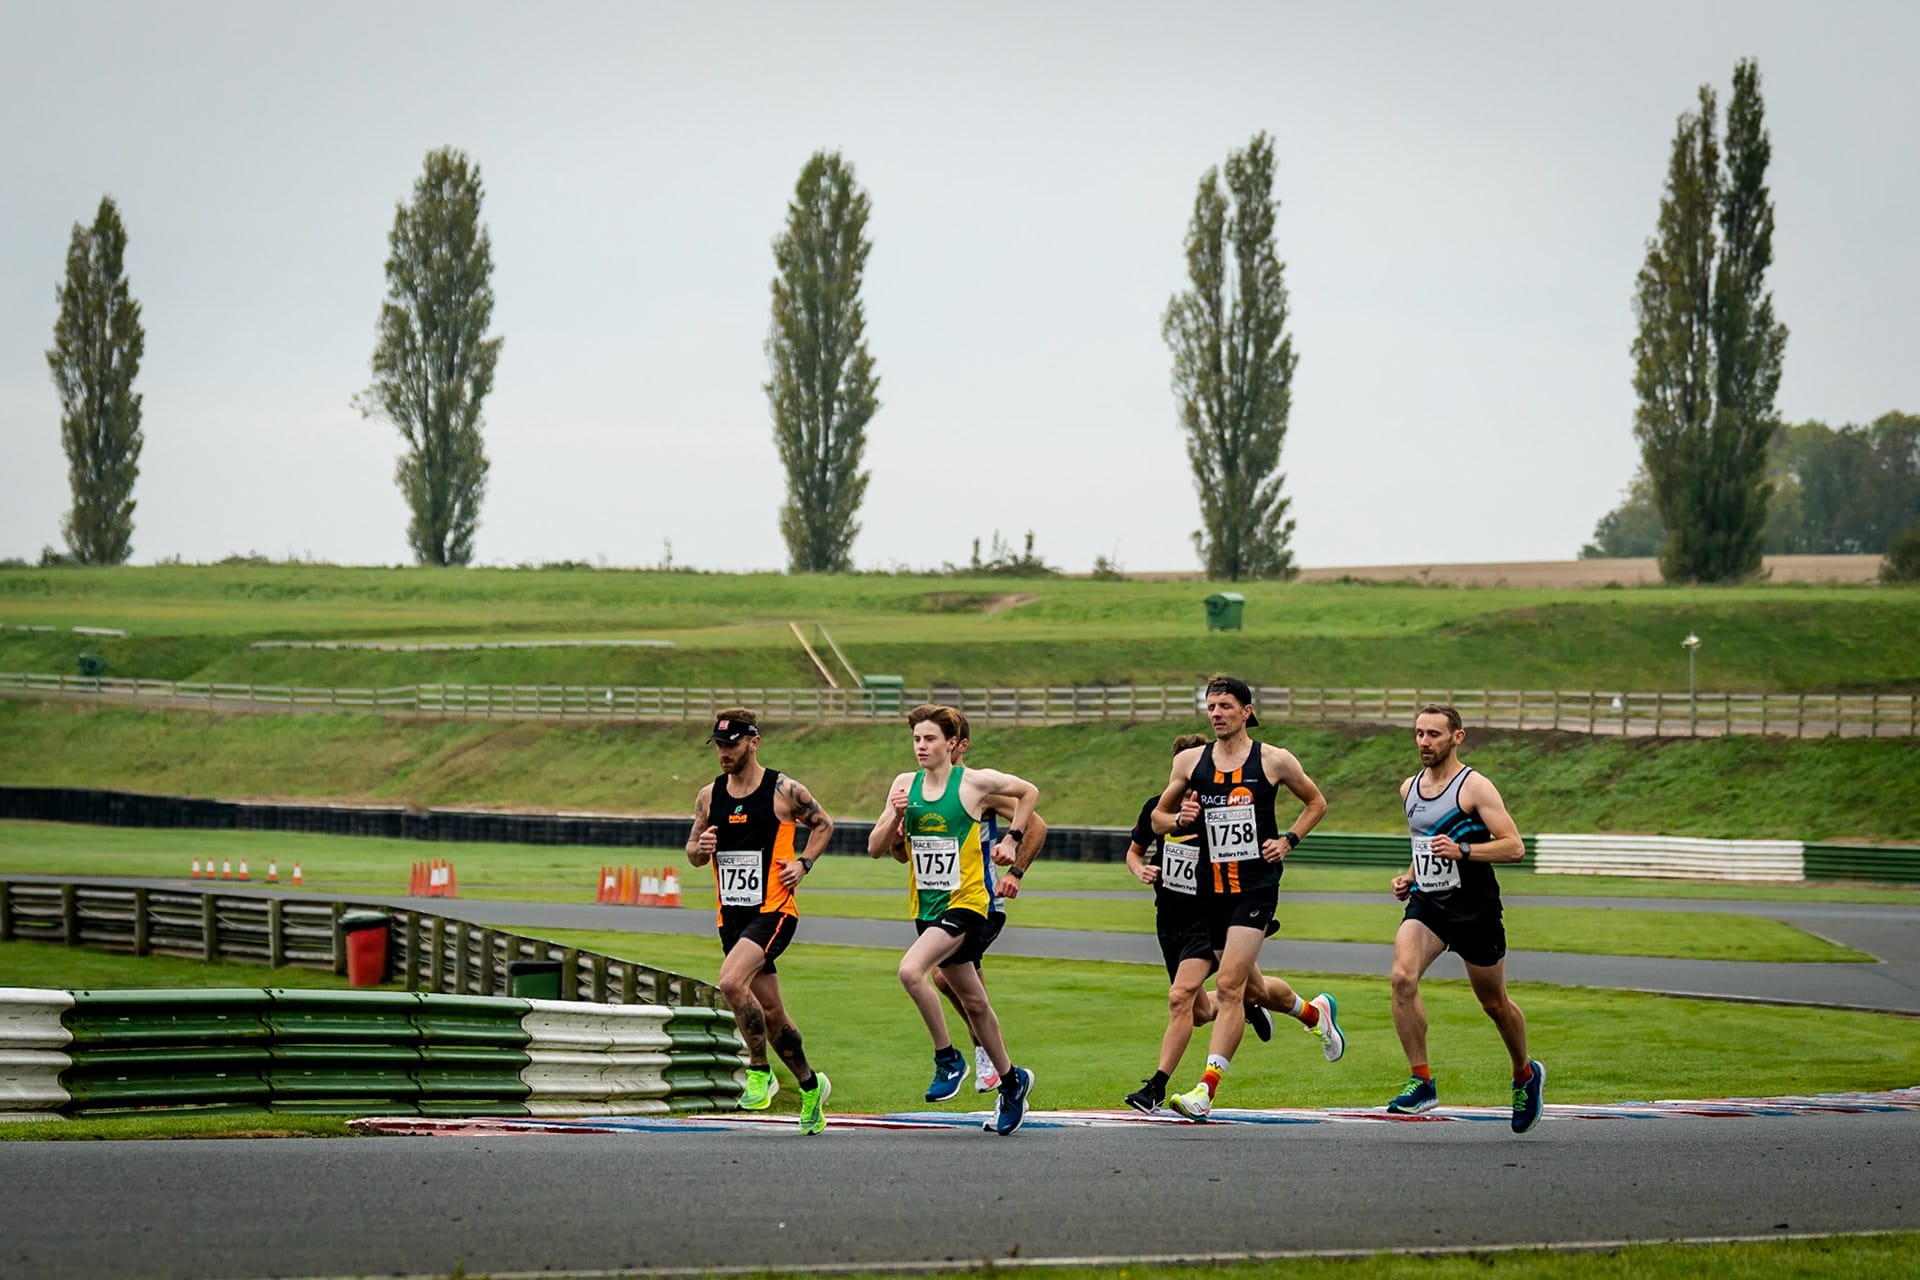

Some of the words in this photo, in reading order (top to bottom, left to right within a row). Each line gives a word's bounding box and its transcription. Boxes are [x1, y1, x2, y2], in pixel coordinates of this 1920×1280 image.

[1200, 795, 1227, 805] RACE
[1208, 812, 1227, 821] RACE
[913, 841, 931, 849] RACE
[1211, 823, 1254, 847] 1758
[1166, 846, 1184, 856] RACE
[916, 853, 956, 874] 1757
[1166, 857, 1194, 881] 176
[1415, 854, 1453, 876] 1759
[721, 869, 759, 890] 1756
